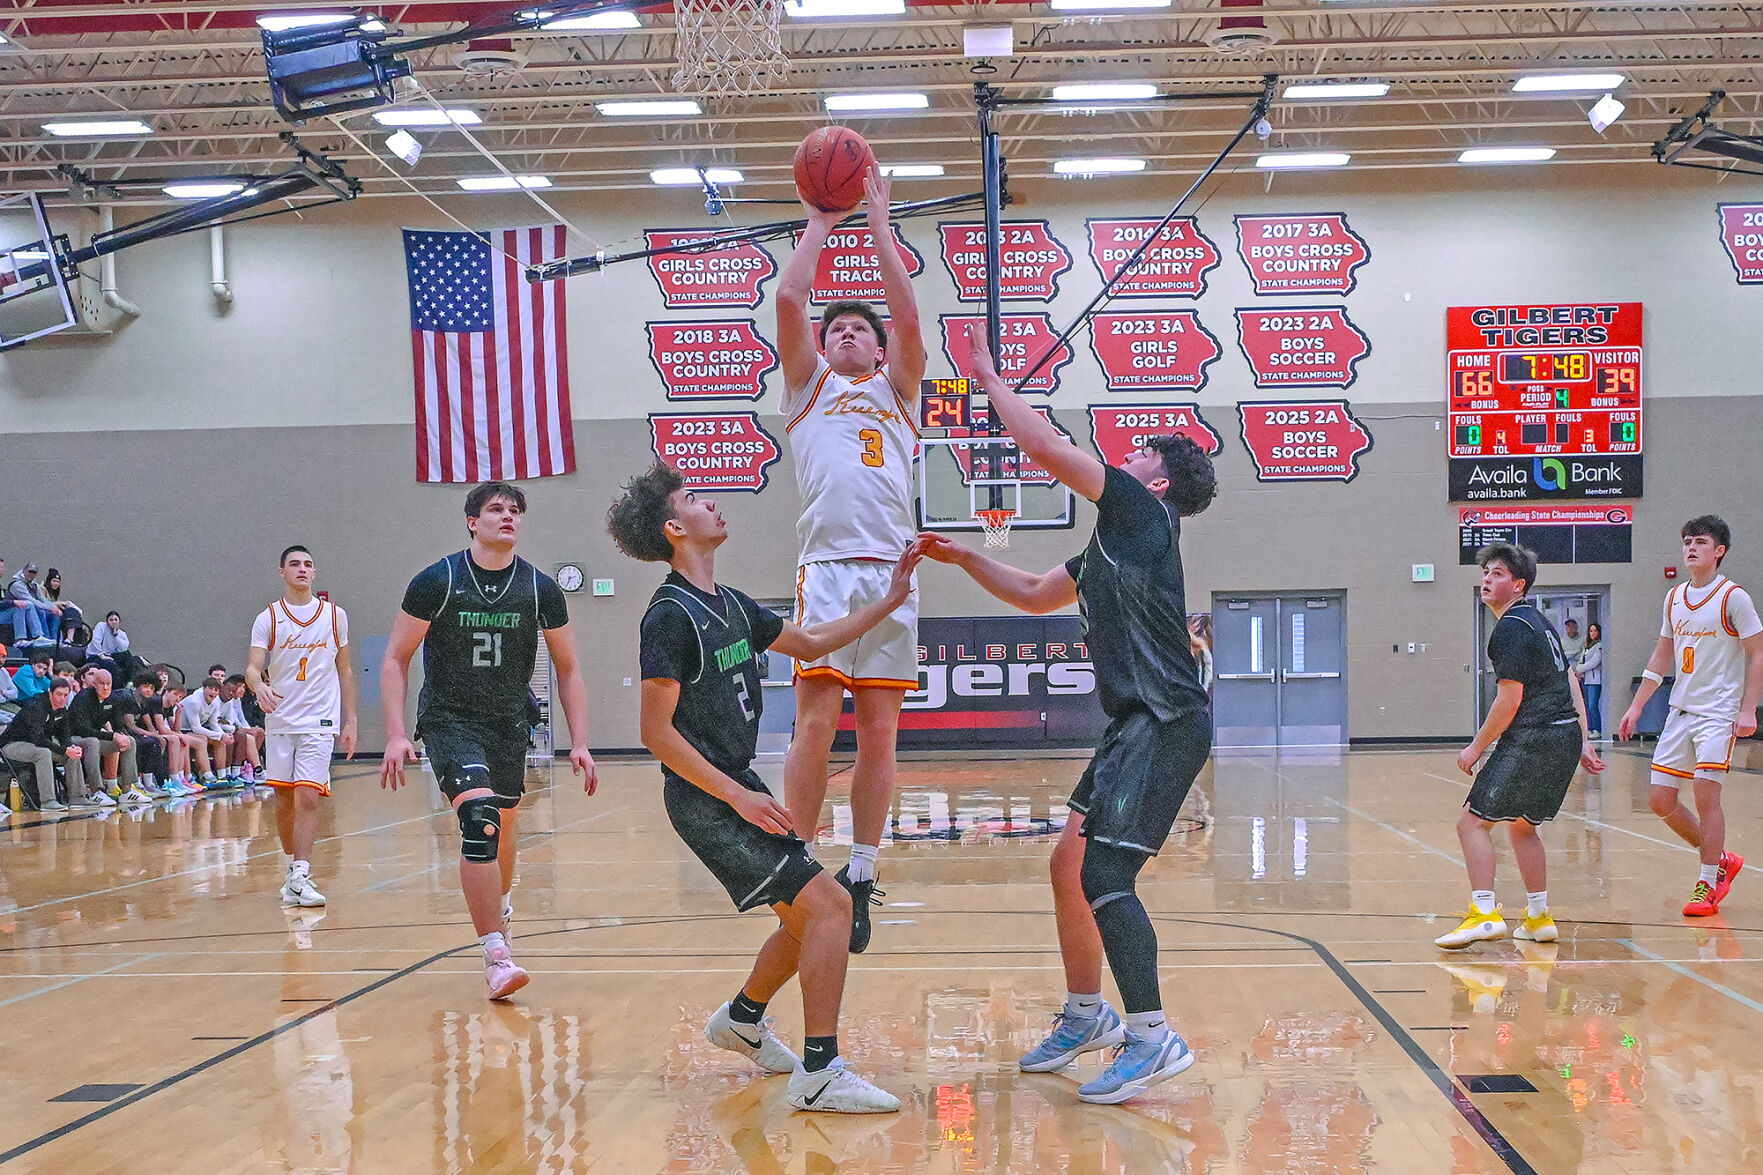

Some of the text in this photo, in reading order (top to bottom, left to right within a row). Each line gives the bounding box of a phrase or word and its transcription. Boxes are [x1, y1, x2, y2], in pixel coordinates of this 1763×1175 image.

[1743, 213, 1763, 226] 20
[965, 230, 1035, 245] 203 2A
[1160, 226, 1185, 240] 3A
[1262, 223, 1333, 238] 2017 3A
[822, 234, 859, 248] 010
[1734, 234, 1763, 247] BO
[952, 251, 1058, 265] GIRL CROSS
[1103, 247, 1205, 262] BOYS CROSS
[1251, 244, 1354, 259] BOYS CROSS
[659, 258, 763, 272] GIRLS CROSS
[833, 255, 879, 267] GIRLS
[1262, 259, 1342, 273] COUNTRY
[830, 270, 883, 282] TRACK
[966, 265, 1045, 279] CONTRY
[1114, 262, 1194, 276] COUNTRY
[671, 271, 749, 285] COUNTRY
[1261, 278, 1344, 288] STATE CHAMPIONS
[817, 289, 843, 297] STATE
[965, 284, 1047, 294] STAT HAMPIONS
[1113, 282, 1195, 291] STATE CHAMPIONS
[671, 291, 751, 301] STATE CHAMPIONS
[1471, 306, 1618, 327] GILBERT
[1012, 322, 1037, 336] 3A
[1111, 320, 1185, 335] 2023 3A
[1259, 316, 1334, 332] 2023 2A
[673, 329, 742, 344] 2018 3A
[1481, 327, 1608, 346] TIGERS
[1000, 343, 1026, 356] OYS
[1130, 341, 1178, 354] GIRLS
[1281, 337, 1325, 351] BOYS
[661, 349, 764, 365] BOYS CROSS
[1132, 355, 1177, 368] GOLF
[1269, 352, 1336, 366] SOCCER
[1457, 355, 1490, 367] HOME
[1594, 352, 1639, 364] VISITOR
[673, 363, 752, 377] COUNTRY
[1000, 358, 1027, 371] OLF
[1522, 354, 1584, 379] 7:48
[1114, 374, 1195, 384] STATE CHAMPIONS
[1262, 371, 1344, 380] STATE CHAMPIONS
[1604, 368, 1635, 393] 39
[673, 383, 753, 392] STATE CHAMPIONS
[931, 379, 968, 394] 7:48
[1462, 372, 1493, 396] 66
[1471, 400, 1499, 409] BONUS
[1521, 393, 1551, 402] PERIOD
[1556, 389, 1568, 408] 4
[1591, 397, 1619, 407] BONUS
[927, 398, 962, 427] 24
[1264, 410, 1339, 425] 2025 2A
[1515, 413, 1582, 424] PLAYER FOULS
[1609, 412, 1636, 421] FOULS
[1115, 413, 1189, 428] 2025 3A
[1455, 416, 1481, 424] FOULS
[672, 420, 745, 436] 2023 3A
[1468, 425, 1480, 445] 0
[1623, 422, 1635, 442] 0
[1283, 431, 1327, 444] BOYS
[1497, 431, 1505, 444] 4
[1586, 429, 1594, 442] 3
[664, 441, 765, 455] BOYS CROSS
[858, 428, 884, 468] 3
[1272, 446, 1338, 459] SOCCER
[1455, 446, 1482, 454] POINTS
[1493, 445, 1509, 454] TOL
[1535, 444, 1562, 453] MATCH
[1581, 444, 1597, 453] TOL
[1609, 443, 1636, 452] POINTS
[676, 456, 753, 470] COUNTRY
[1264, 464, 1346, 474] STATE CHAMPIONS
[703, 475, 755, 483] CHAMPIONS
[1003, 471, 1050, 479] HAPIONS
[1468, 461, 1622, 485] Availa Bank
[1467, 487, 1527, 499] availa.bank
[1485, 509, 1605, 521] Cheerleading State Championships
[458, 611, 521, 628] THUNDER
[473, 632, 502, 667] 21
[1682, 646, 1695, 675] 0
[296, 657, 308, 681] 1
[901, 662, 1096, 709] gers
[732, 672, 755, 722] 2
